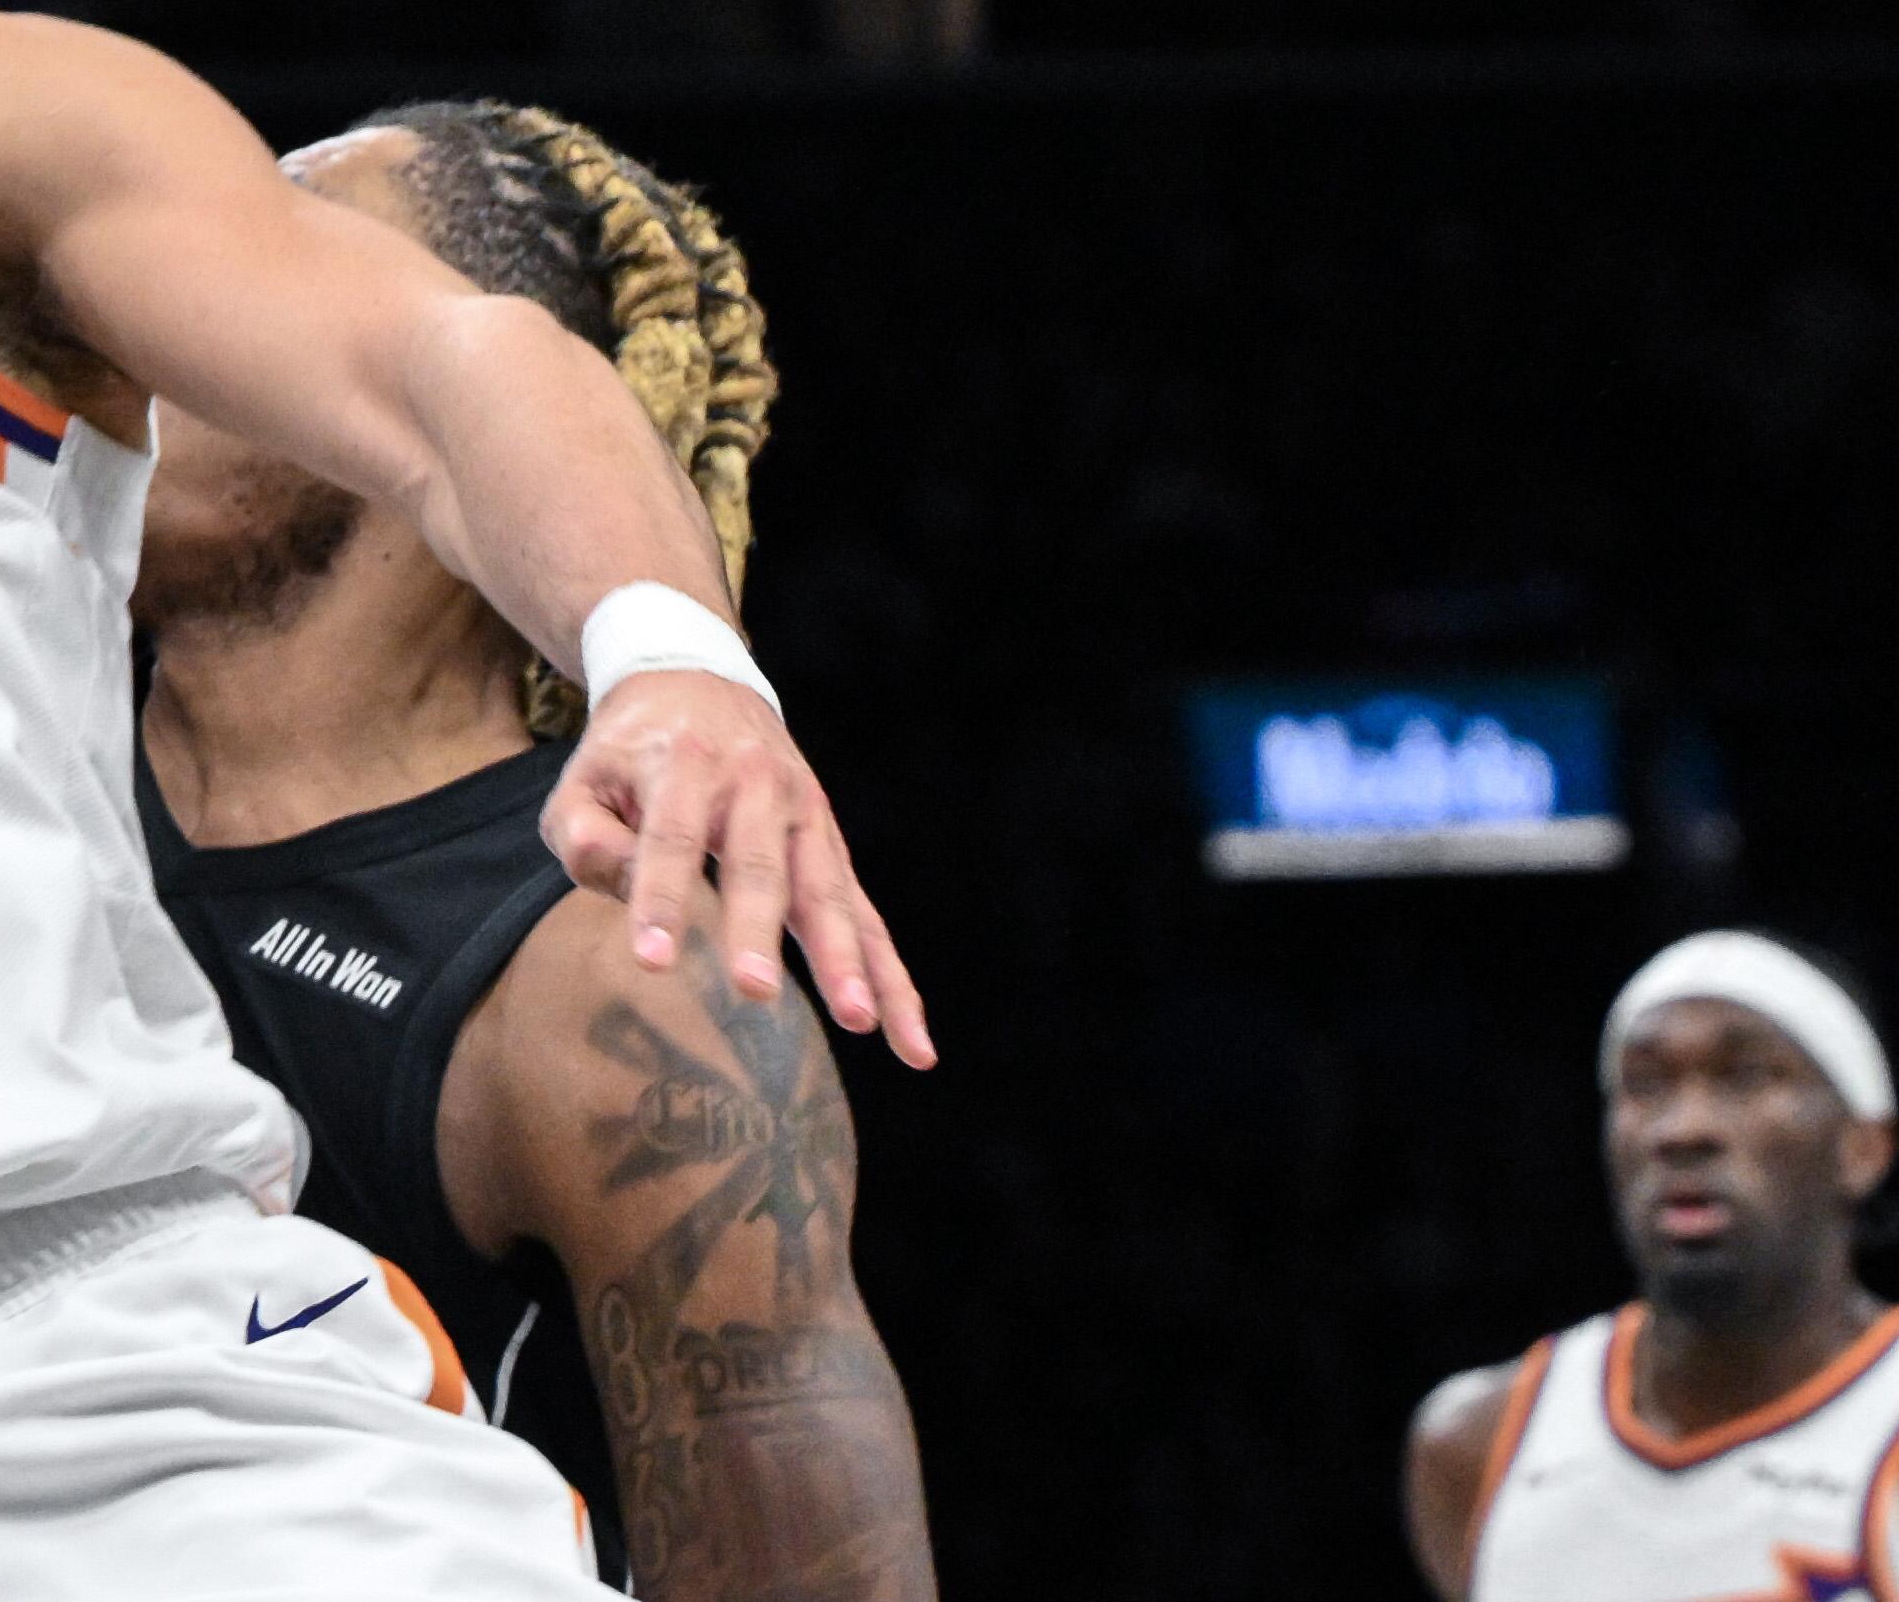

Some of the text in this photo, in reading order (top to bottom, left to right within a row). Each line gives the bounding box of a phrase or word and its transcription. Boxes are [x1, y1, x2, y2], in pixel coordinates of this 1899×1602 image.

[249, 917, 403, 1009] All In Won
